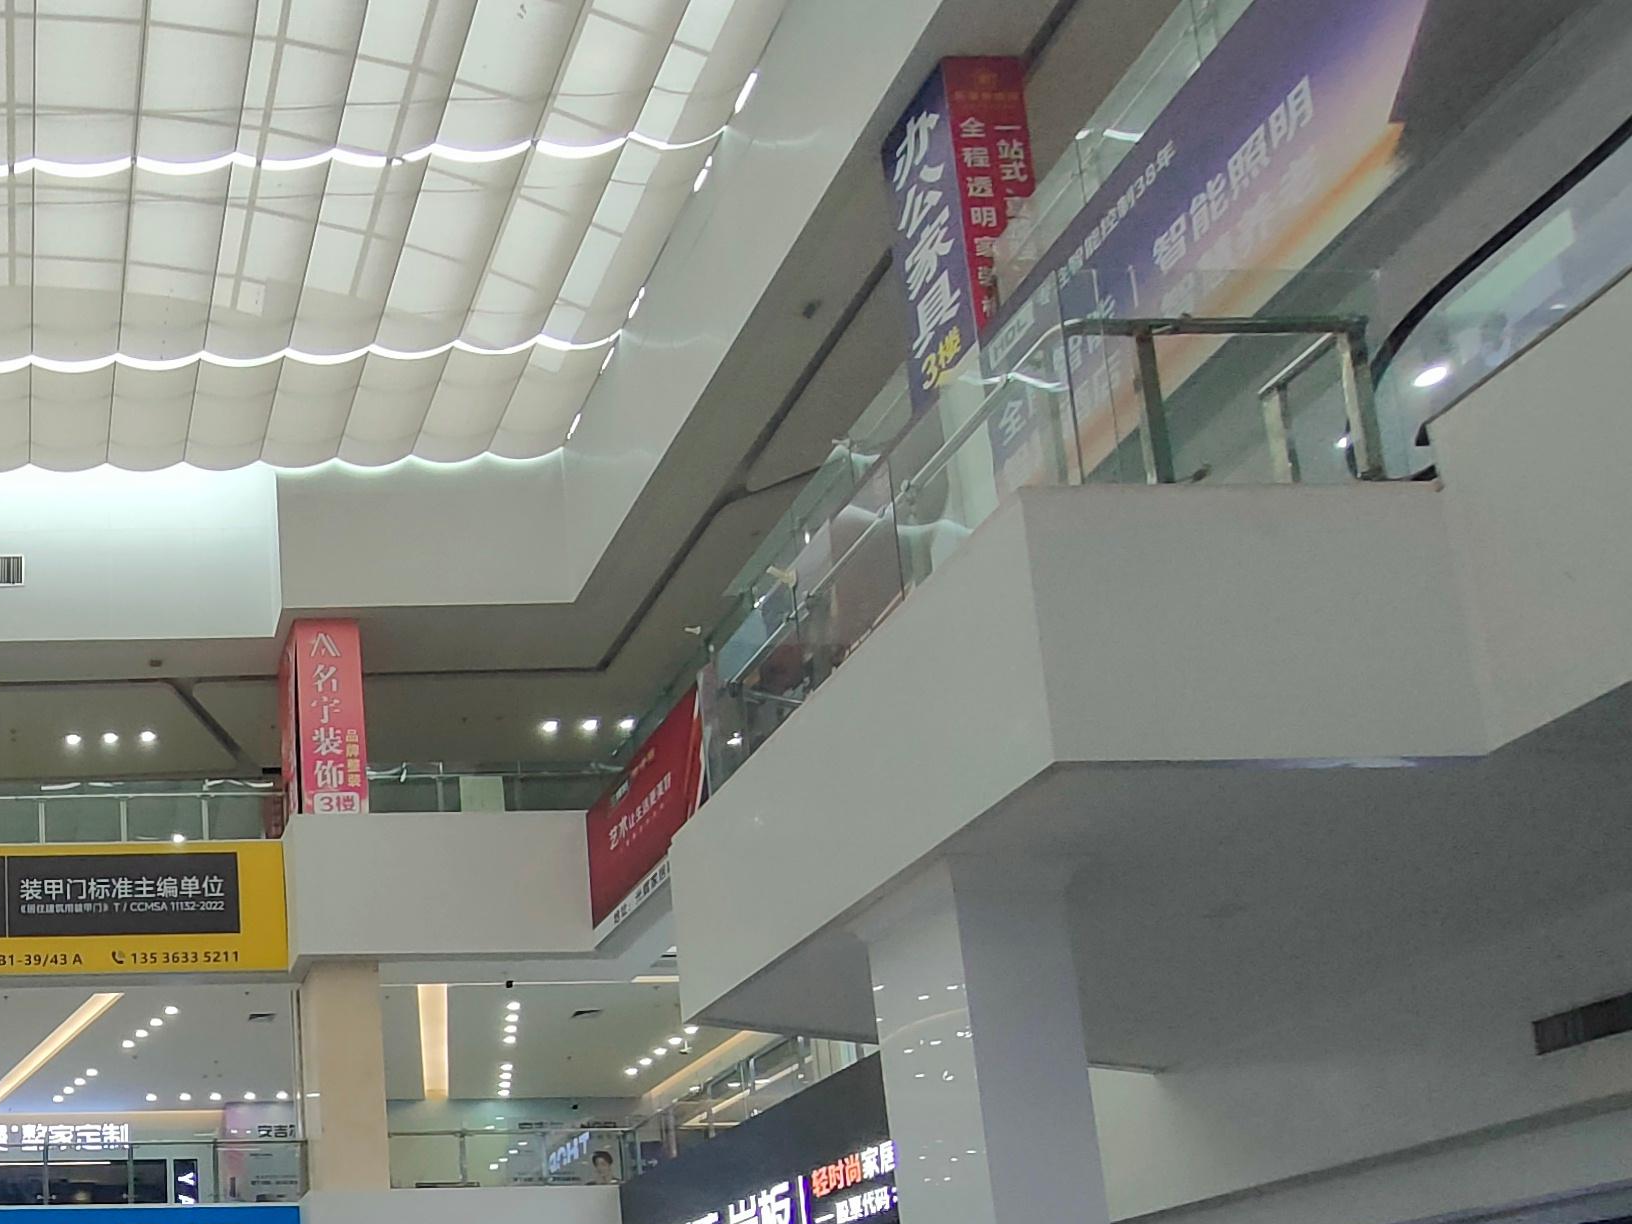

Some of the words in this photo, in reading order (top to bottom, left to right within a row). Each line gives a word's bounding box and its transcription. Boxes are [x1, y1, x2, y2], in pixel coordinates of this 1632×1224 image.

[1153, 74, 1314, 273] 智能照明
[893, 111, 961, 358] 办公家具
[19, 875, 225, 902] 装甲门标准主编单位
[131, 952, 158, 965] 135
[162, 951, 200, 964] 3633
[203, 950, 240, 963] 5211
